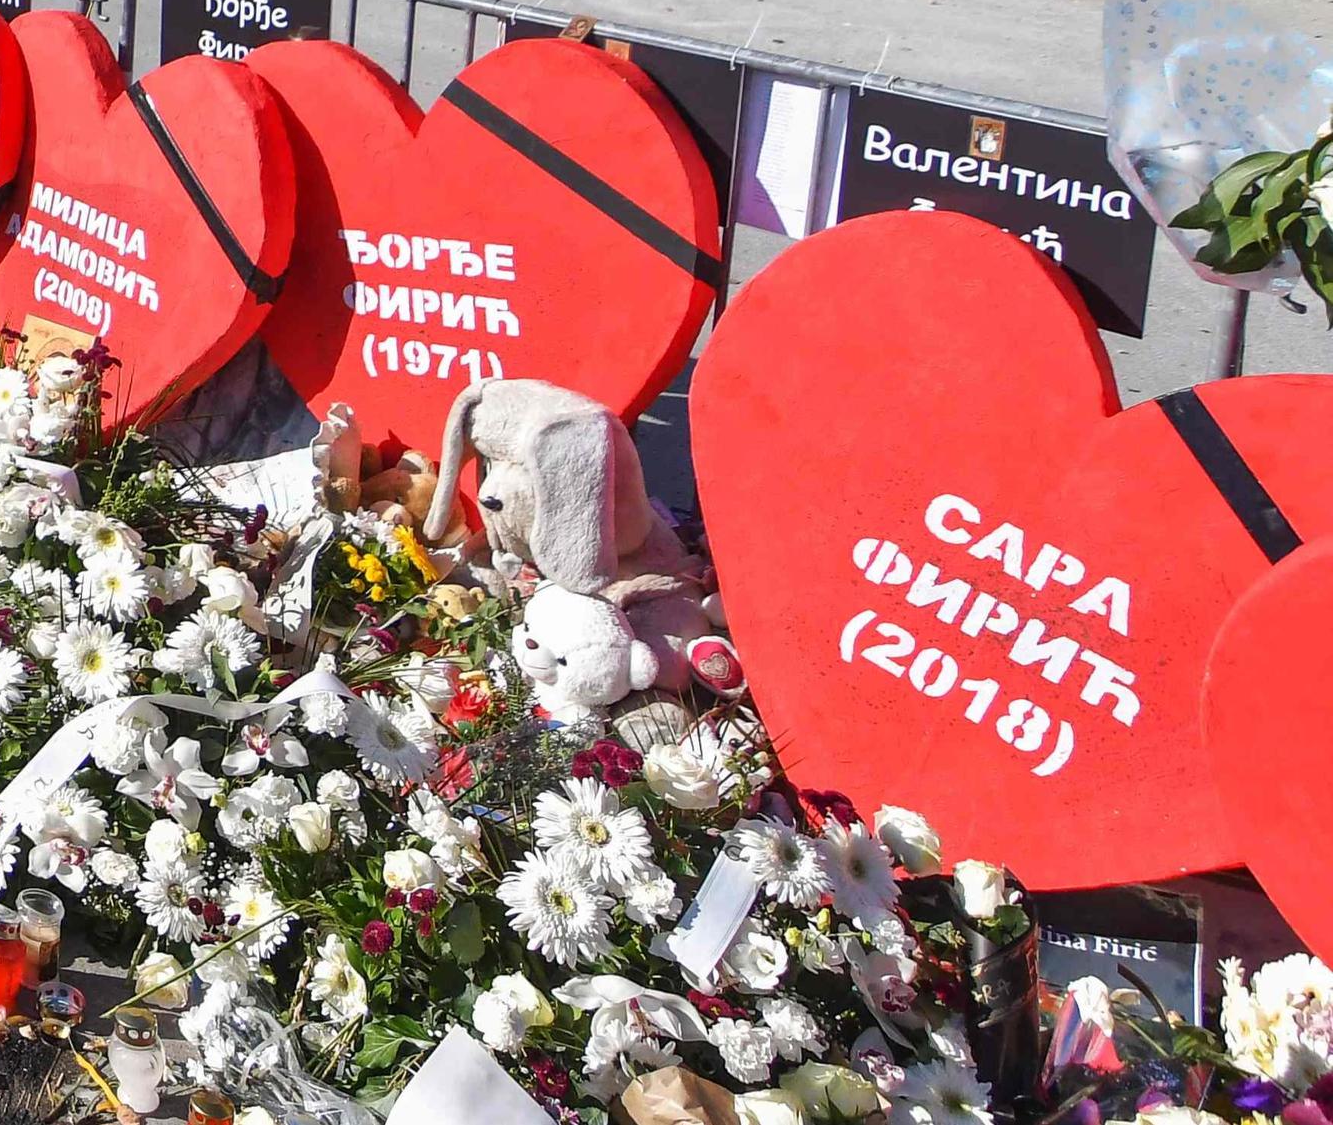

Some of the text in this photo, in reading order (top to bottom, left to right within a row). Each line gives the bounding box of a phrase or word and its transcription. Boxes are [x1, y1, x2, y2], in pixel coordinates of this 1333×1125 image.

[863, 124, 1133, 221] Валентина
[31, 182, 146, 260] МИЛИЦА
[338, 229, 516, 281] ЂОРЂЕ
[5, 212, 159, 312] АДАМОВИЋ
[34, 267, 112, 338] (2008)
[343, 281, 520, 336] ФИРИЋ
[362, 333, 504, 387] (1971)
[924, 493, 1131, 637] САРА
[852, 537, 1141, 727] ФИРИЋ
[839, 609, 1075, 777] (2018)
[1093, 935, 1158, 963] Firić
